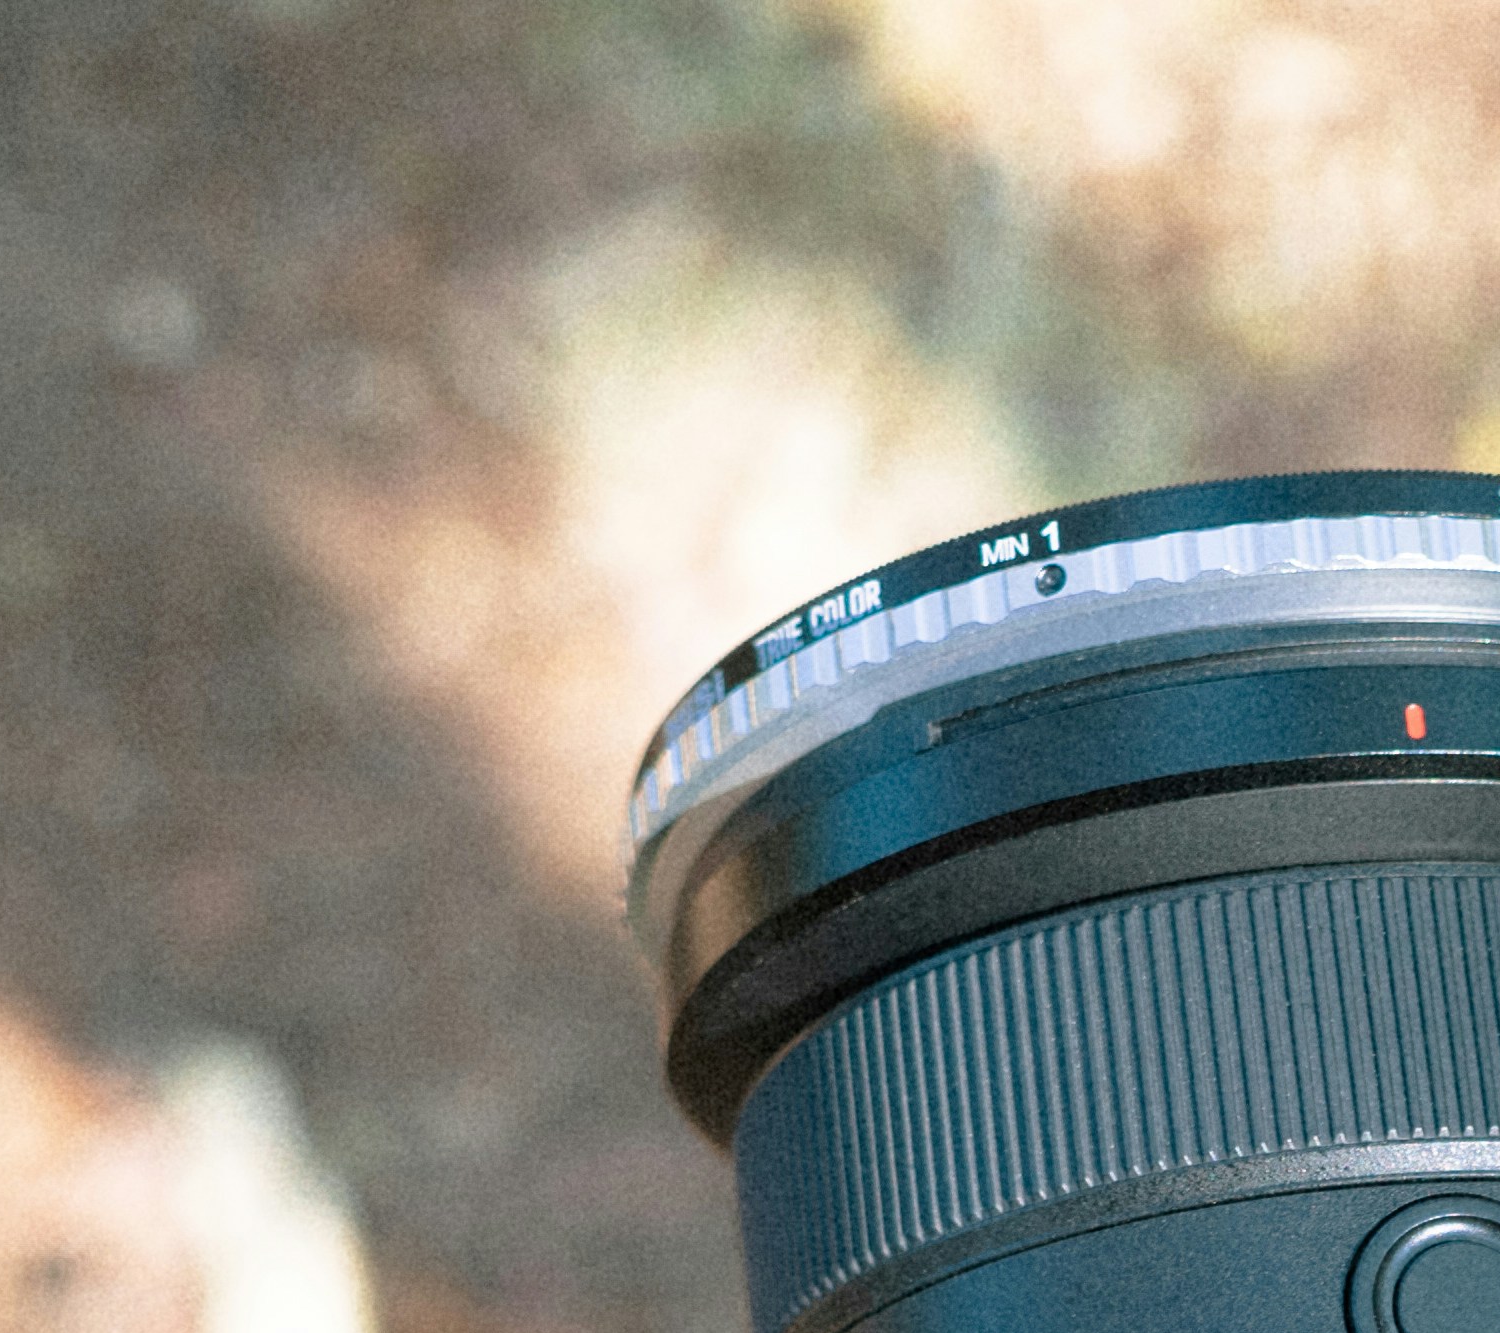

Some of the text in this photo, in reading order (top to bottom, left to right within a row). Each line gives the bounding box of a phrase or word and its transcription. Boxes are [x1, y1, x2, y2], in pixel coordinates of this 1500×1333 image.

[981, 520, 1061, 568] MIN 1
[754, 578, 884, 672] TRUE COLOR
